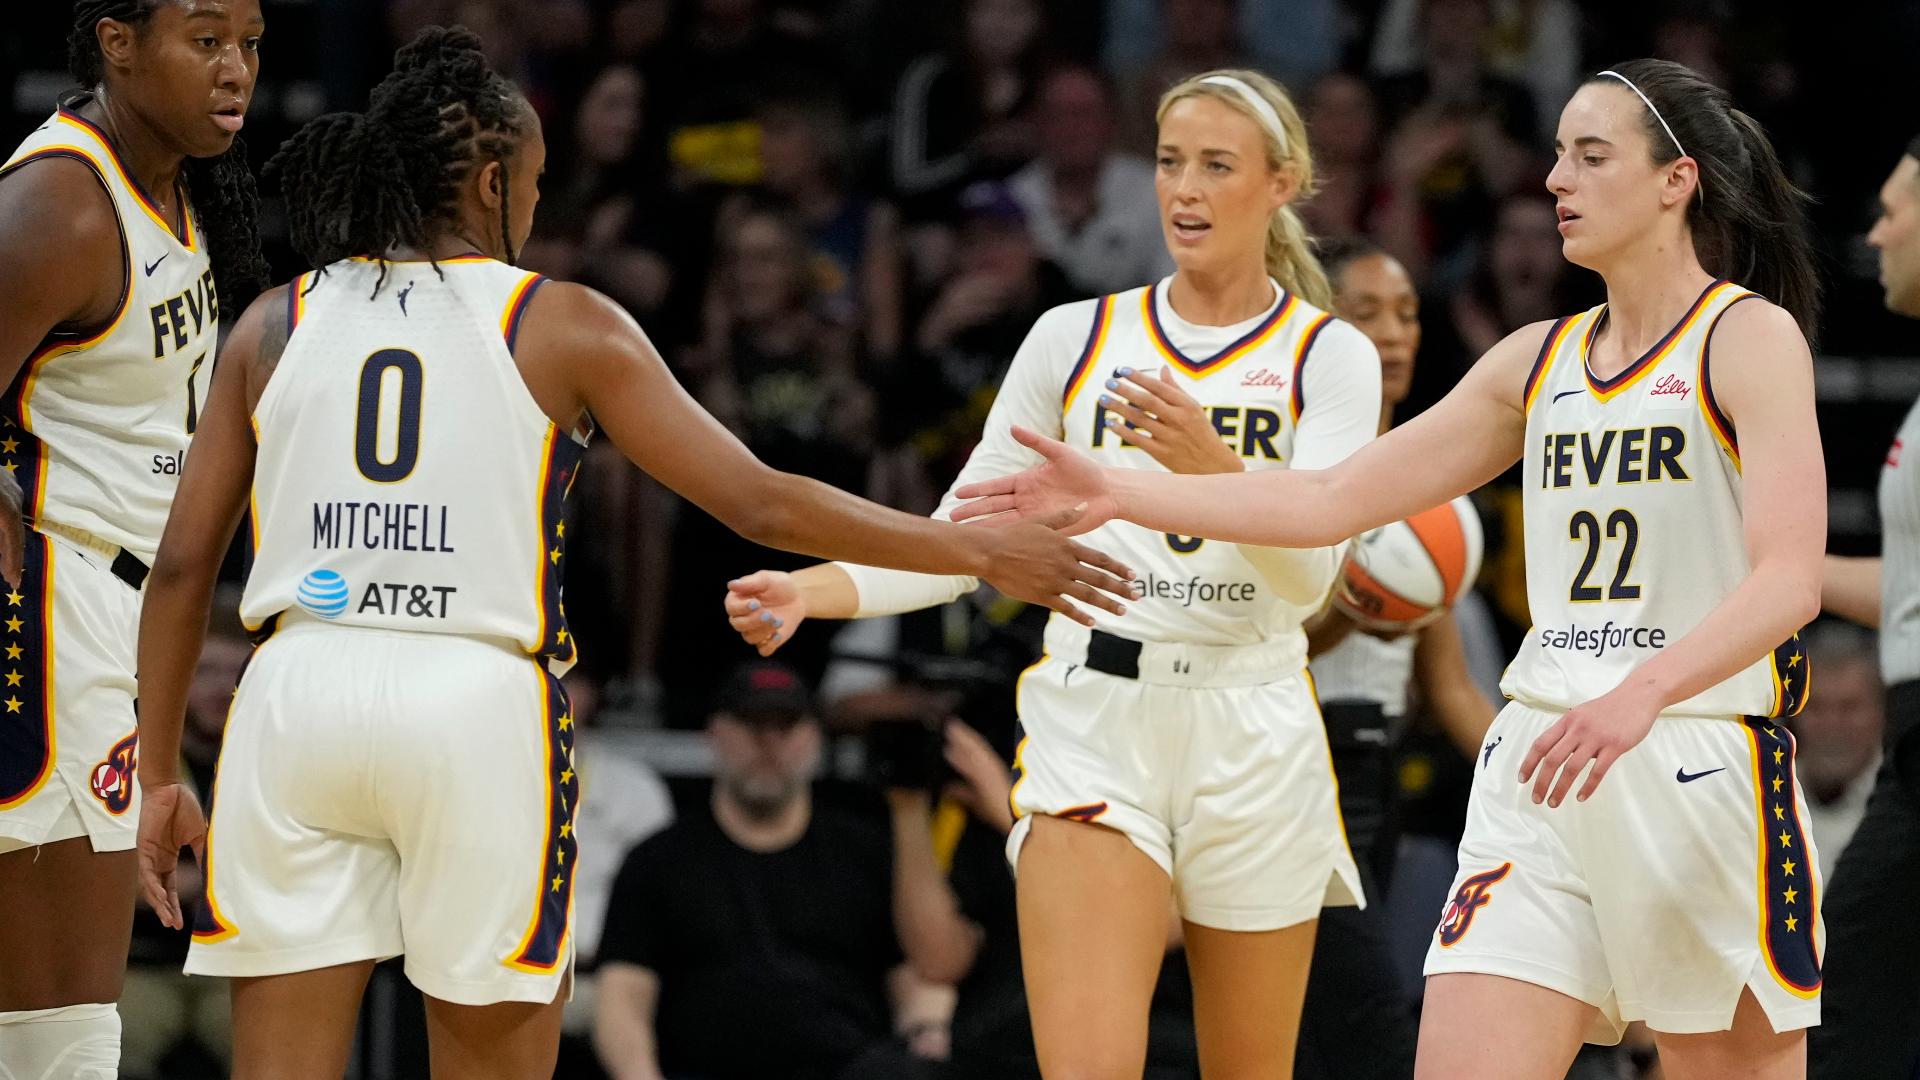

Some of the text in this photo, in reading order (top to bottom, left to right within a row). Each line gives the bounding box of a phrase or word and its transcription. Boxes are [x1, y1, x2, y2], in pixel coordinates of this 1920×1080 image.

[1240, 368, 1287, 391] Lilly
[1650, 373, 1692, 400] Lilly
[354, 347, 425, 485] 0
[1092, 398, 1282, 461] FER
[1542, 425, 1693, 490] FEVER
[313, 502, 454, 552] MITCHELL
[1568, 508, 1641, 602] 22
[357, 582, 457, 618] AT&T
[1120, 573, 1256, 607] alesforce
[1541, 621, 1666, 658] salesforce
